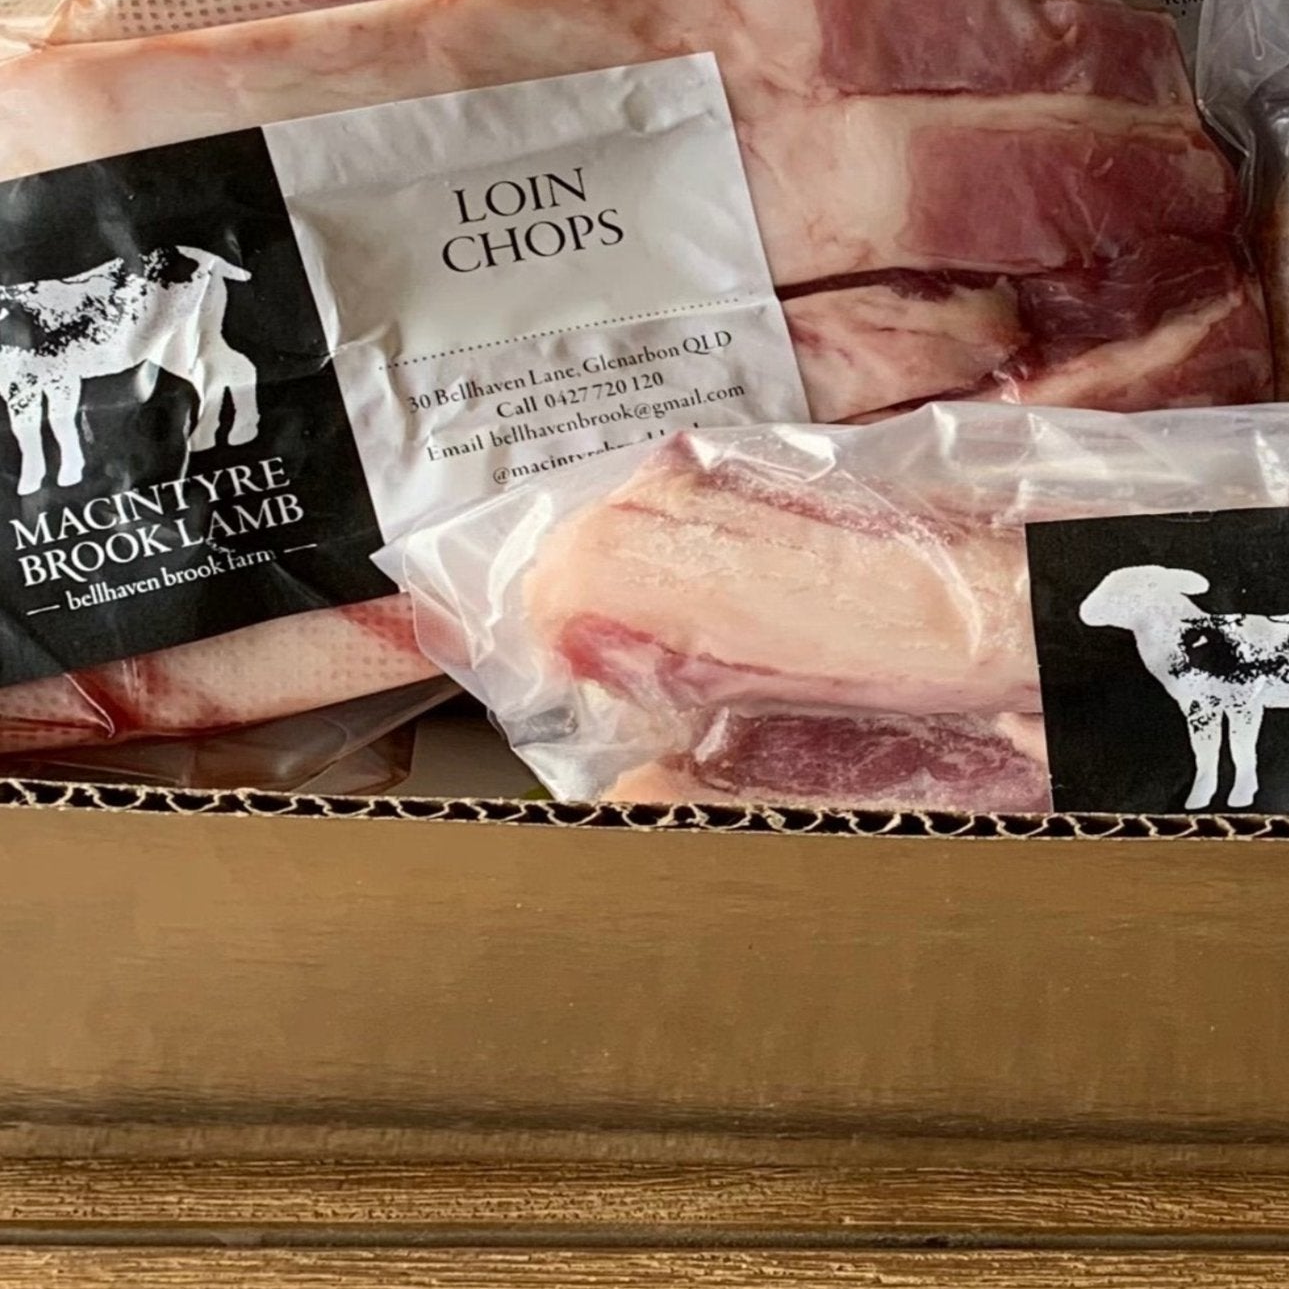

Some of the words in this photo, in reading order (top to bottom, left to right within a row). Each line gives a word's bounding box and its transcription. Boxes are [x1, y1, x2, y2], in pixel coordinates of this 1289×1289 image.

[453, 167, 587, 225] LOIN
[442, 208, 624, 273] CHOPS
[407, 393, 431, 414] 30
[435, 375, 525, 406] Bellhaven
[529, 365, 581, 386] Lane,
[583, 345, 680, 374] Glenarbon
[683, 330, 732, 355] QLD
[427, 435, 483, 461] Email
[490, 383, 745, 448] bellhavenbrook@gmail.com
[497, 400, 538, 419] Call
[9, 457, 290, 551] MACINTYRE
[18, 524, 172, 587] BROOK
[174, 493, 304, 548] LAMB
[66, 576, 161, 610] bellhaven
[161, 555, 226, 588] brook
[225, 549, 276, 570] farm
